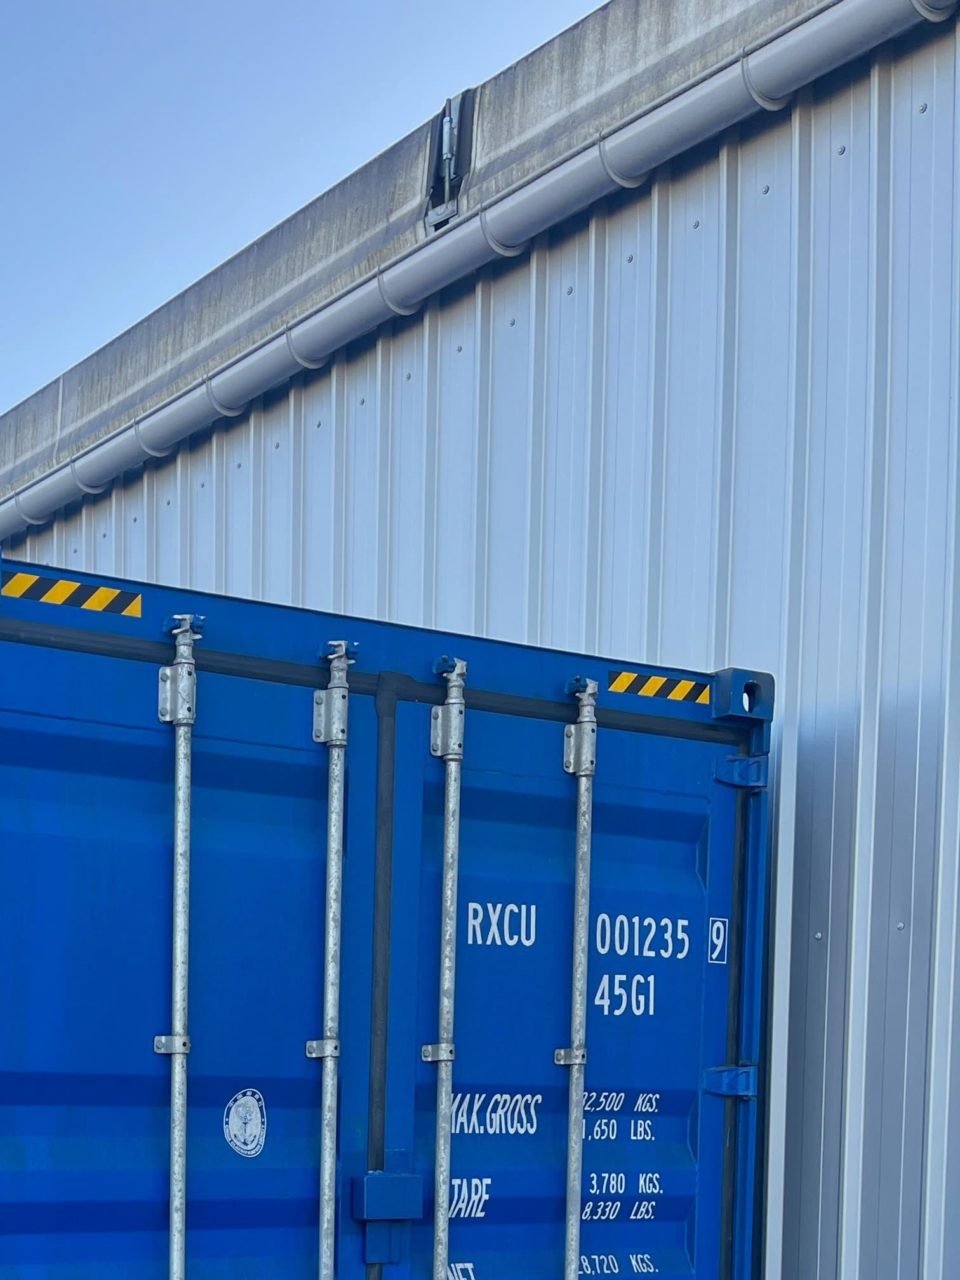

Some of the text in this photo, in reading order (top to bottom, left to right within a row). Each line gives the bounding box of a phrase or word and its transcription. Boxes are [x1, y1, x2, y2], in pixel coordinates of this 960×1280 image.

[467, 902, 727, 963] RXCU 001235 9
[594, 974, 655, 1016] 45G1
[634, 1094, 660, 1113] KGS.
[630, 1119, 655, 1141] LBS.
[589, 1173, 663, 1195] 3,780 KGS.
[448, 1178, 492, 1218] TARE
[581, 1201, 656, 1220] 8,330 LBS.
[578, 1254, 659, 1275] 8,720 KGS.
